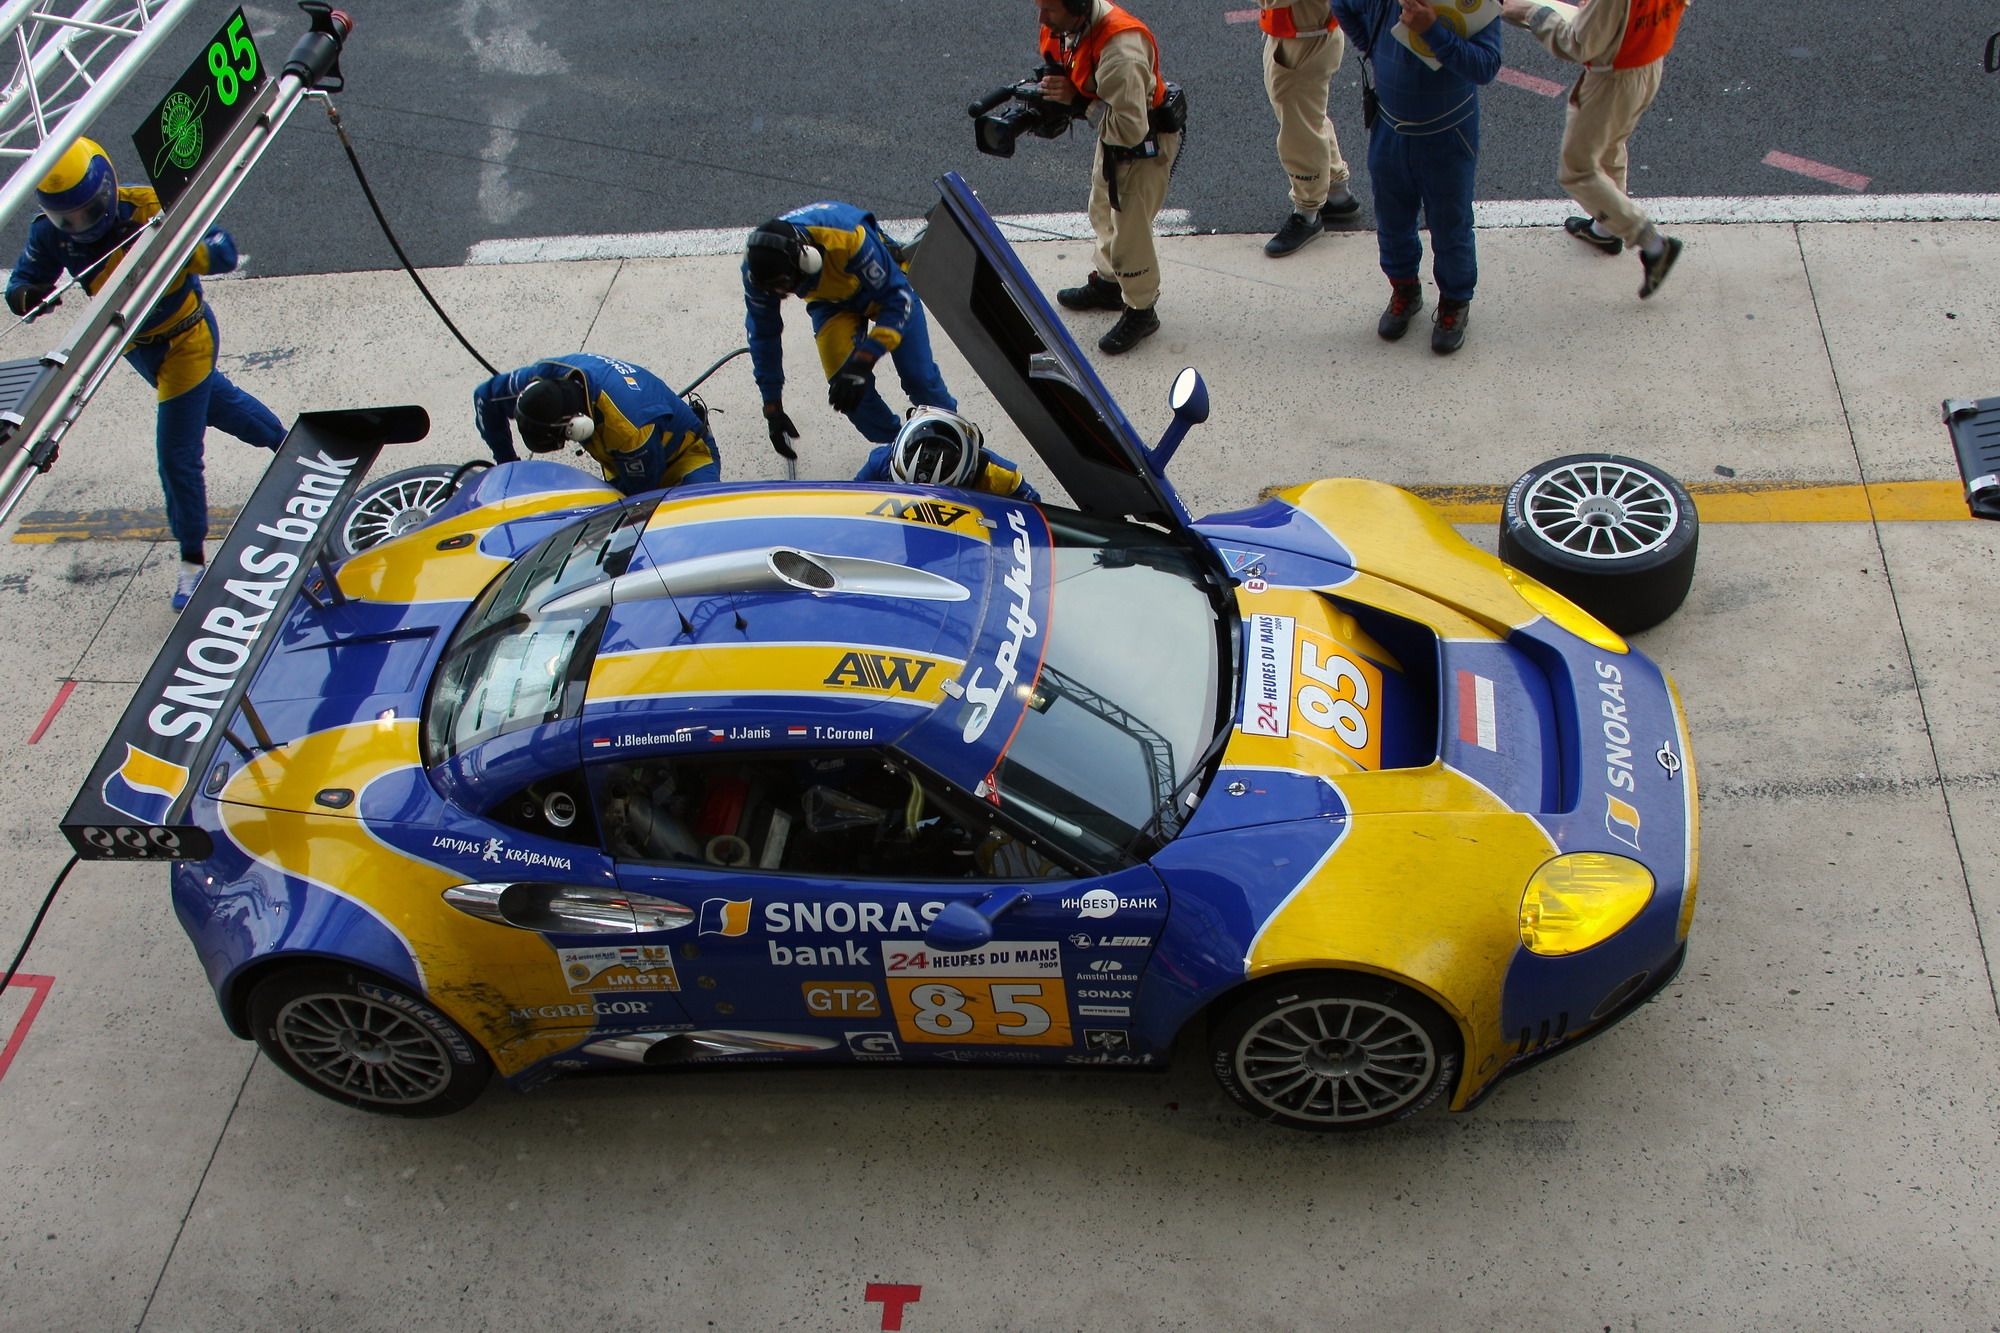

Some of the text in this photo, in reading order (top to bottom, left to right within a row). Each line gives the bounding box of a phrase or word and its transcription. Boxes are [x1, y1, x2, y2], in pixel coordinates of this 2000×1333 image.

[208, 14, 256, 106] 85
[162, 94, 191, 134] SPYKER
[148, 449, 360, 743] SNORAS bank
[962, 509, 1037, 744] Spyker
[1257, 615, 1278, 733] 24 HEURES DU MANS
[1297, 640, 1370, 750] 85
[614, 726, 874, 748] J.Bleekemolen J.Janis T.Coronel
[1594, 660, 1635, 793] SNORAS
[432, 836, 572, 870] LATVIJAS KRĀJBANKA
[764, 901, 946, 933] SNORAS
[768, 940, 871, 966] bank
[888, 952, 929, 971] 24
[990, 952, 1009, 964] DU
[1015, 948, 1058, 963] MANS
[1099, 936, 1152, 947] LEMO
[1076, 972, 1138, 981] Amstel Lease
[1077, 989, 1133, 999] SONAX
[807, 988, 876, 1011] GT2
[909, 983, 1052, 1037] 85
[387, 994, 472, 1062] MICHELIN
